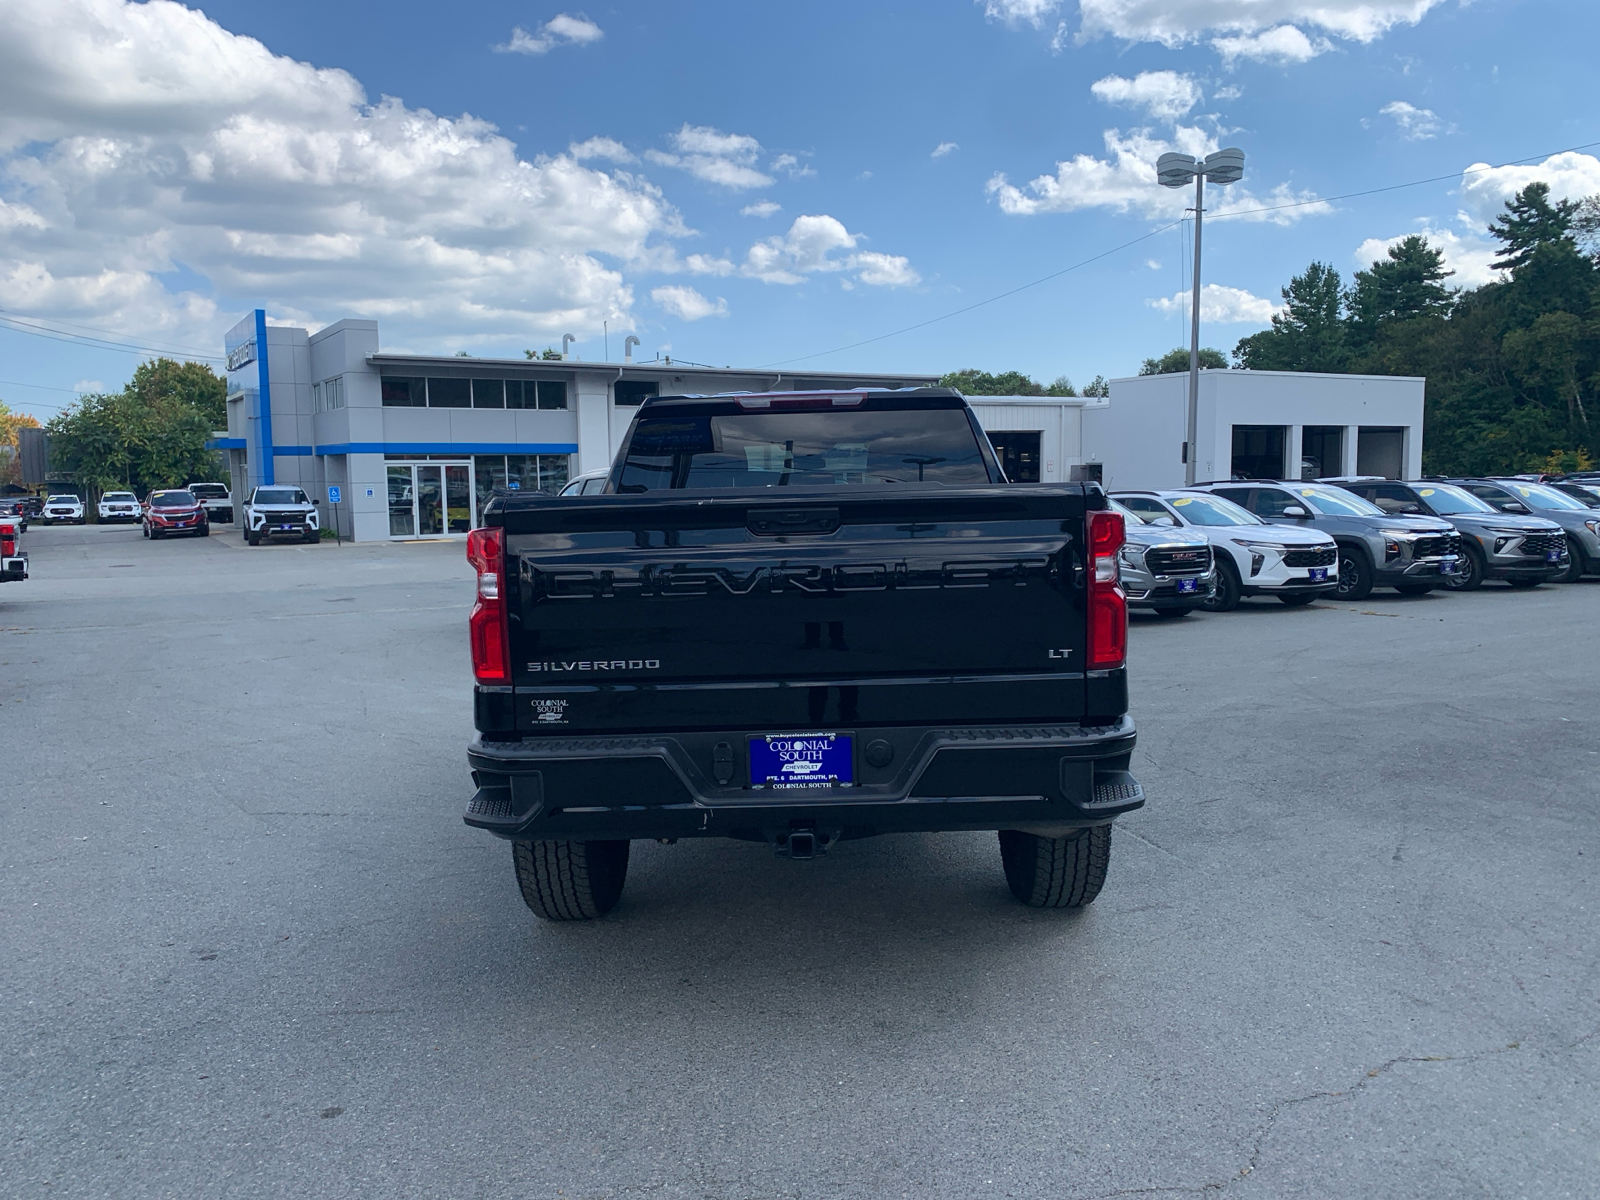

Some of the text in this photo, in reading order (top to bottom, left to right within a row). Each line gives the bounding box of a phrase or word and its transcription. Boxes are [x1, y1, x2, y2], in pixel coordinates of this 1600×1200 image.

[544, 558, 1050, 599] CHEVROLET
[1049, 649, 1073, 658] LT
[527, 659, 660, 672] SILVERADO
[769, 740, 832, 752] COLONIAL
[779, 750, 823, 761] SOUTH
